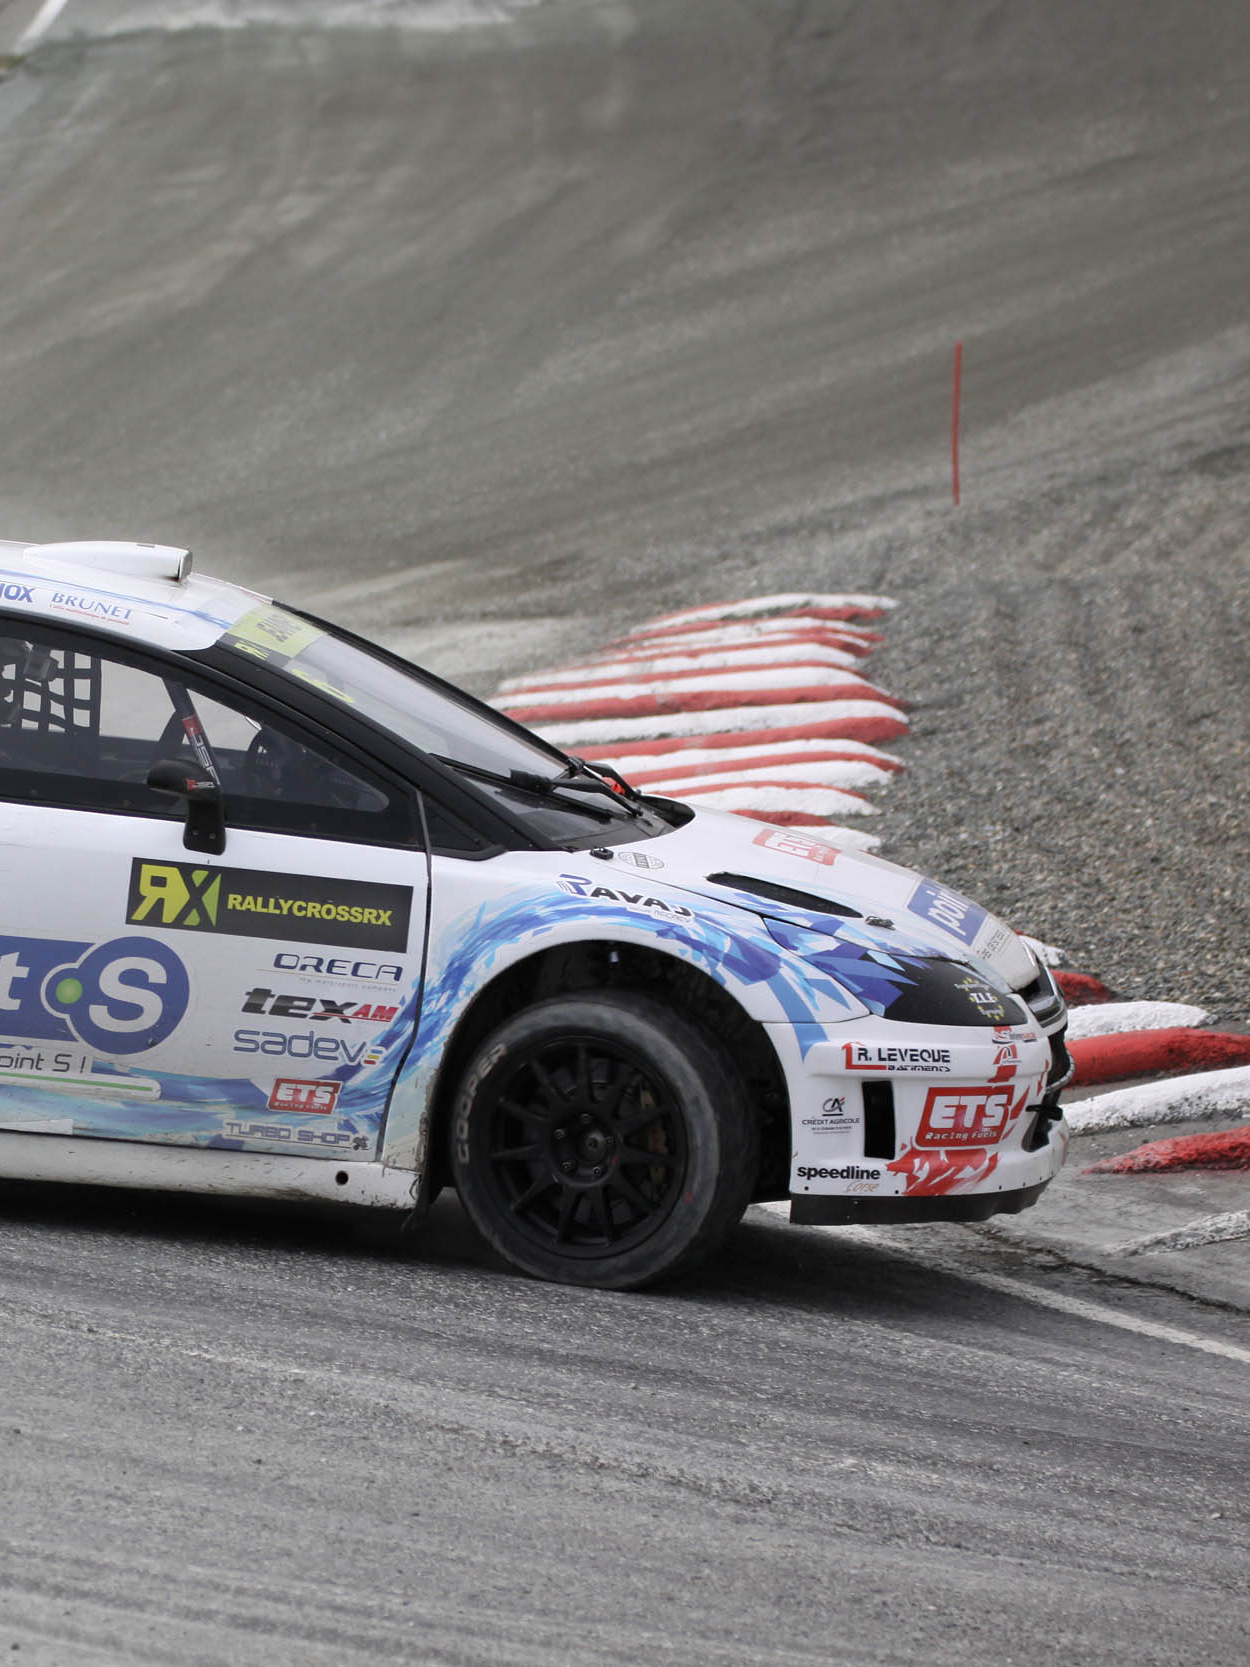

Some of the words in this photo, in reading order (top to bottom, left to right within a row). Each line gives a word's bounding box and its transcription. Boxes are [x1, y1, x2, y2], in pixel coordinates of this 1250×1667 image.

[51, 592, 133, 620] BRUNET
[227, 893, 393, 927] RALLYCROSSRX
[273, 953, 404, 982] ORECA
[89, 956, 168, 1033] S
[233, 1030, 367, 1063] sadev
[857, 1047, 872, 1062] R.
[877, 1047, 951, 1063] LEVEQUE
[52, 1053, 72, 1073] S
[276, 1082, 335, 1105] ETS
[456, 1043, 507, 1163] COOPER
[929, 1094, 1010, 1129] ETS
[225, 1122, 291, 1140] TURBO
[298, 1130, 351, 1145] SHOP
[797, 1166, 880, 1181] speedline
